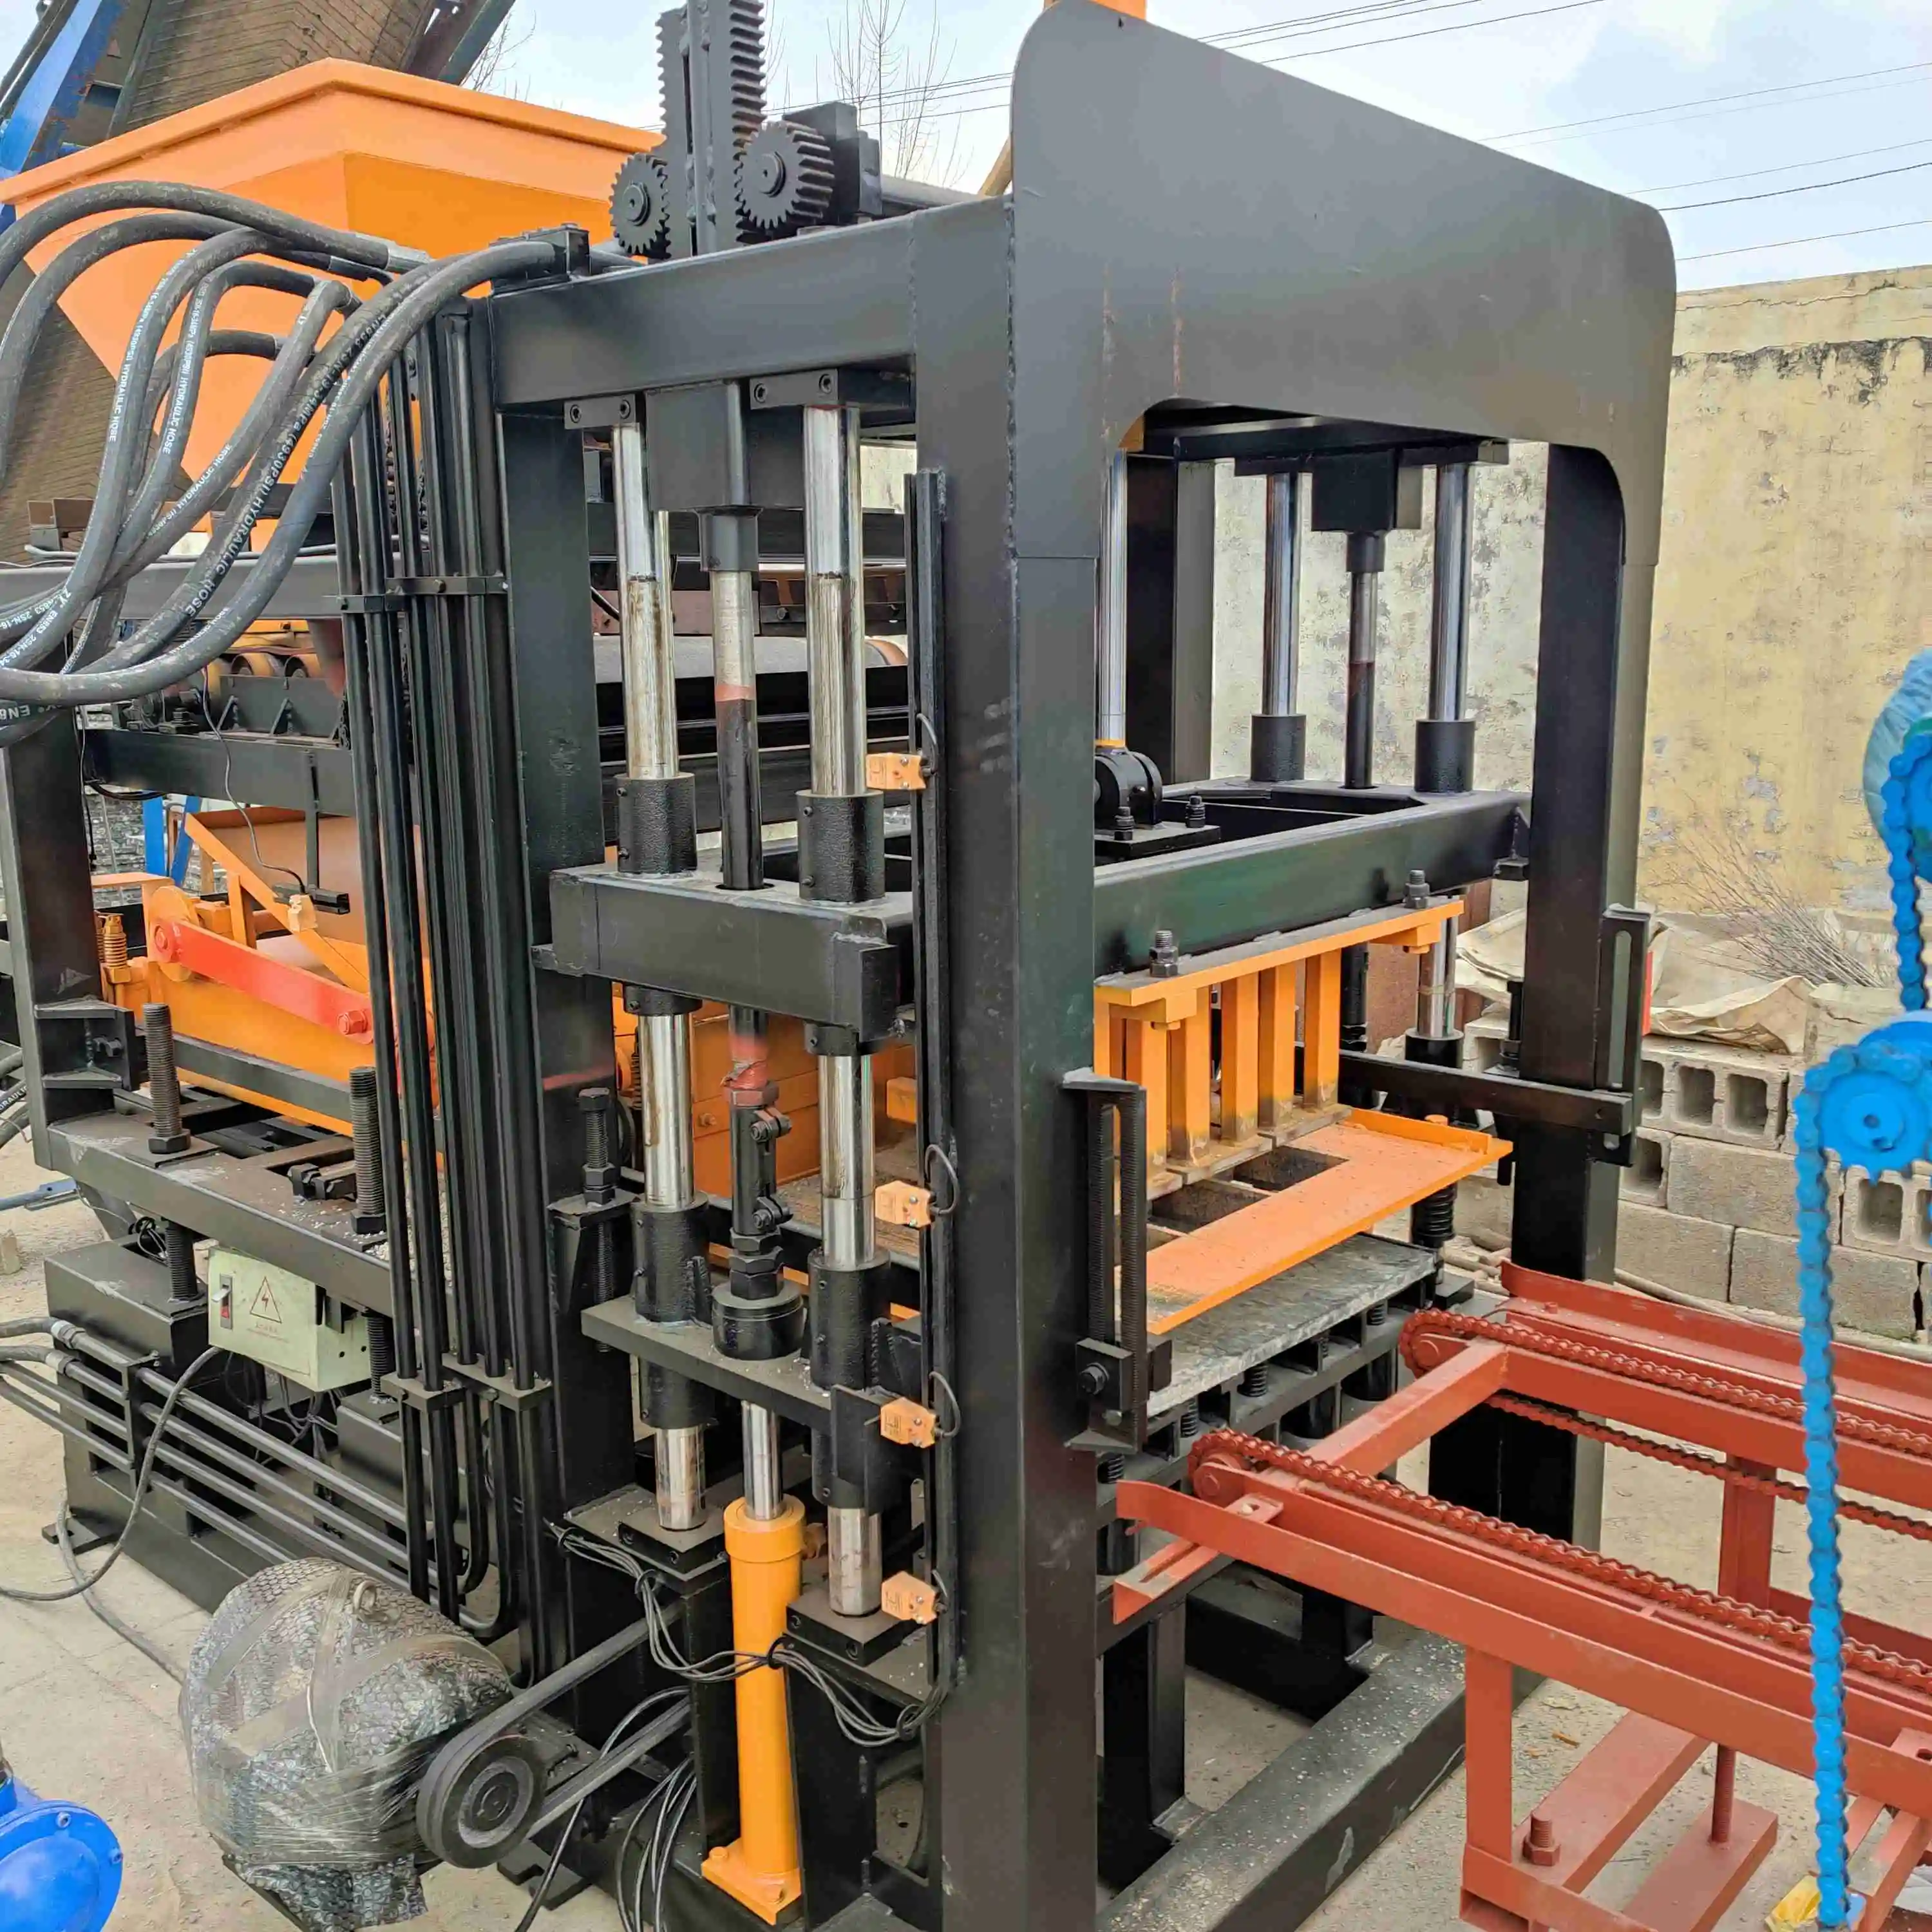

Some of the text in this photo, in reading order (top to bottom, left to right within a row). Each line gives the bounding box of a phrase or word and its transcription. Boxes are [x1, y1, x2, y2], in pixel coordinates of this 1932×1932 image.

[114, 364, 131, 415] HYDRAULIC
[171, 377, 189, 427] HYDRAULIC
[109, 416, 120, 442] HOSE
[162, 428, 177, 454] HOSE
[177, 467, 215, 509] HYDRAULIC
[213, 443, 232, 467] HOSE
[259, 433, 297, 496] (4930PSI)
[216, 497, 265, 574] HYDRAULIC
[185, 579, 216, 617] HOSE
